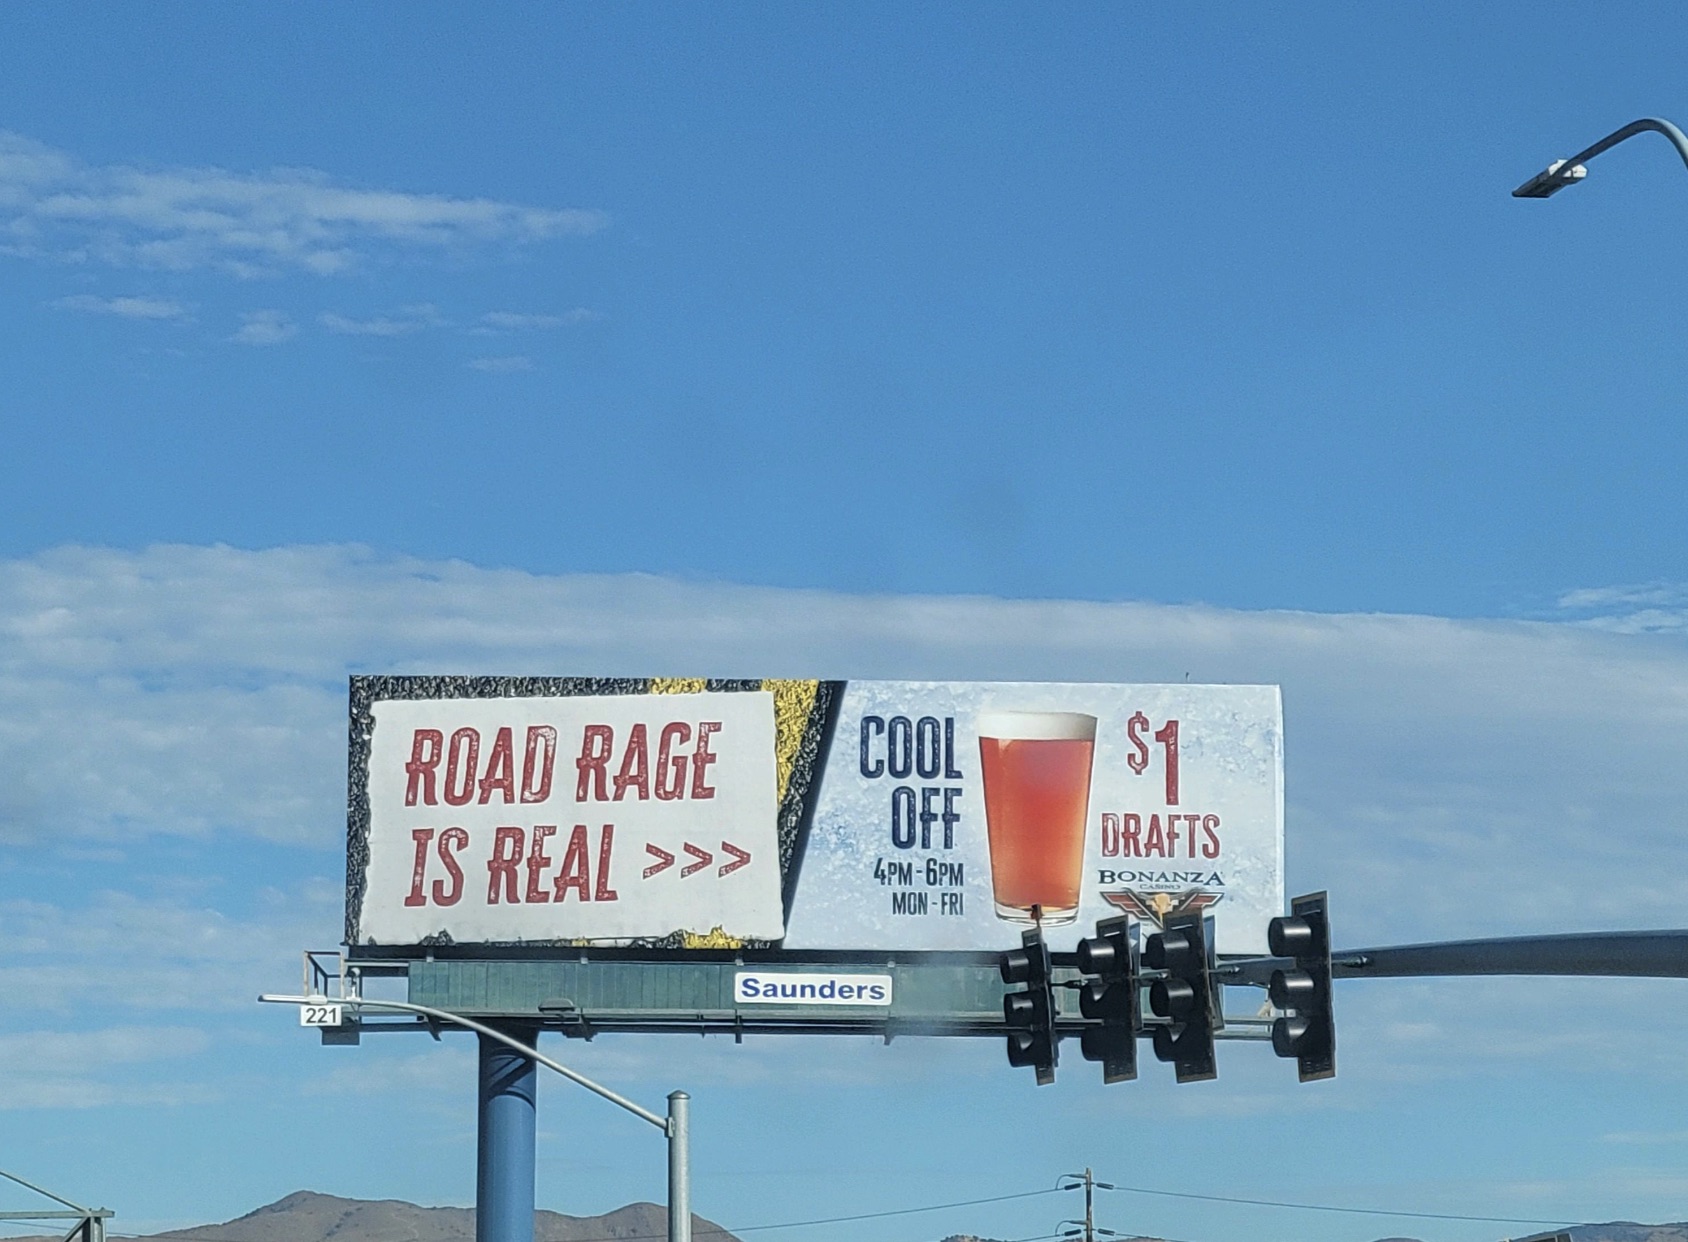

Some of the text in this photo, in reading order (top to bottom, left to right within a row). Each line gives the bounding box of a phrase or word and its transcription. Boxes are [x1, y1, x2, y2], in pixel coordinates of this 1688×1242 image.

[405, 721, 722, 806] ROAD RAGE
[859, 715, 963, 779] COOL
[1127, 711, 1179, 806] $1
[891, 786, 963, 850] OFF
[1101, 813, 1220, 859] DRAFTS
[404, 824, 618, 907] IS REAL
[1098, 869, 1225, 886] BONANZA
[892, 891, 928, 916] MON
[941, 892, 964, 916] FRI
[305, 1007, 336, 1023] 221
[741, 978, 885, 1000] Saunders
